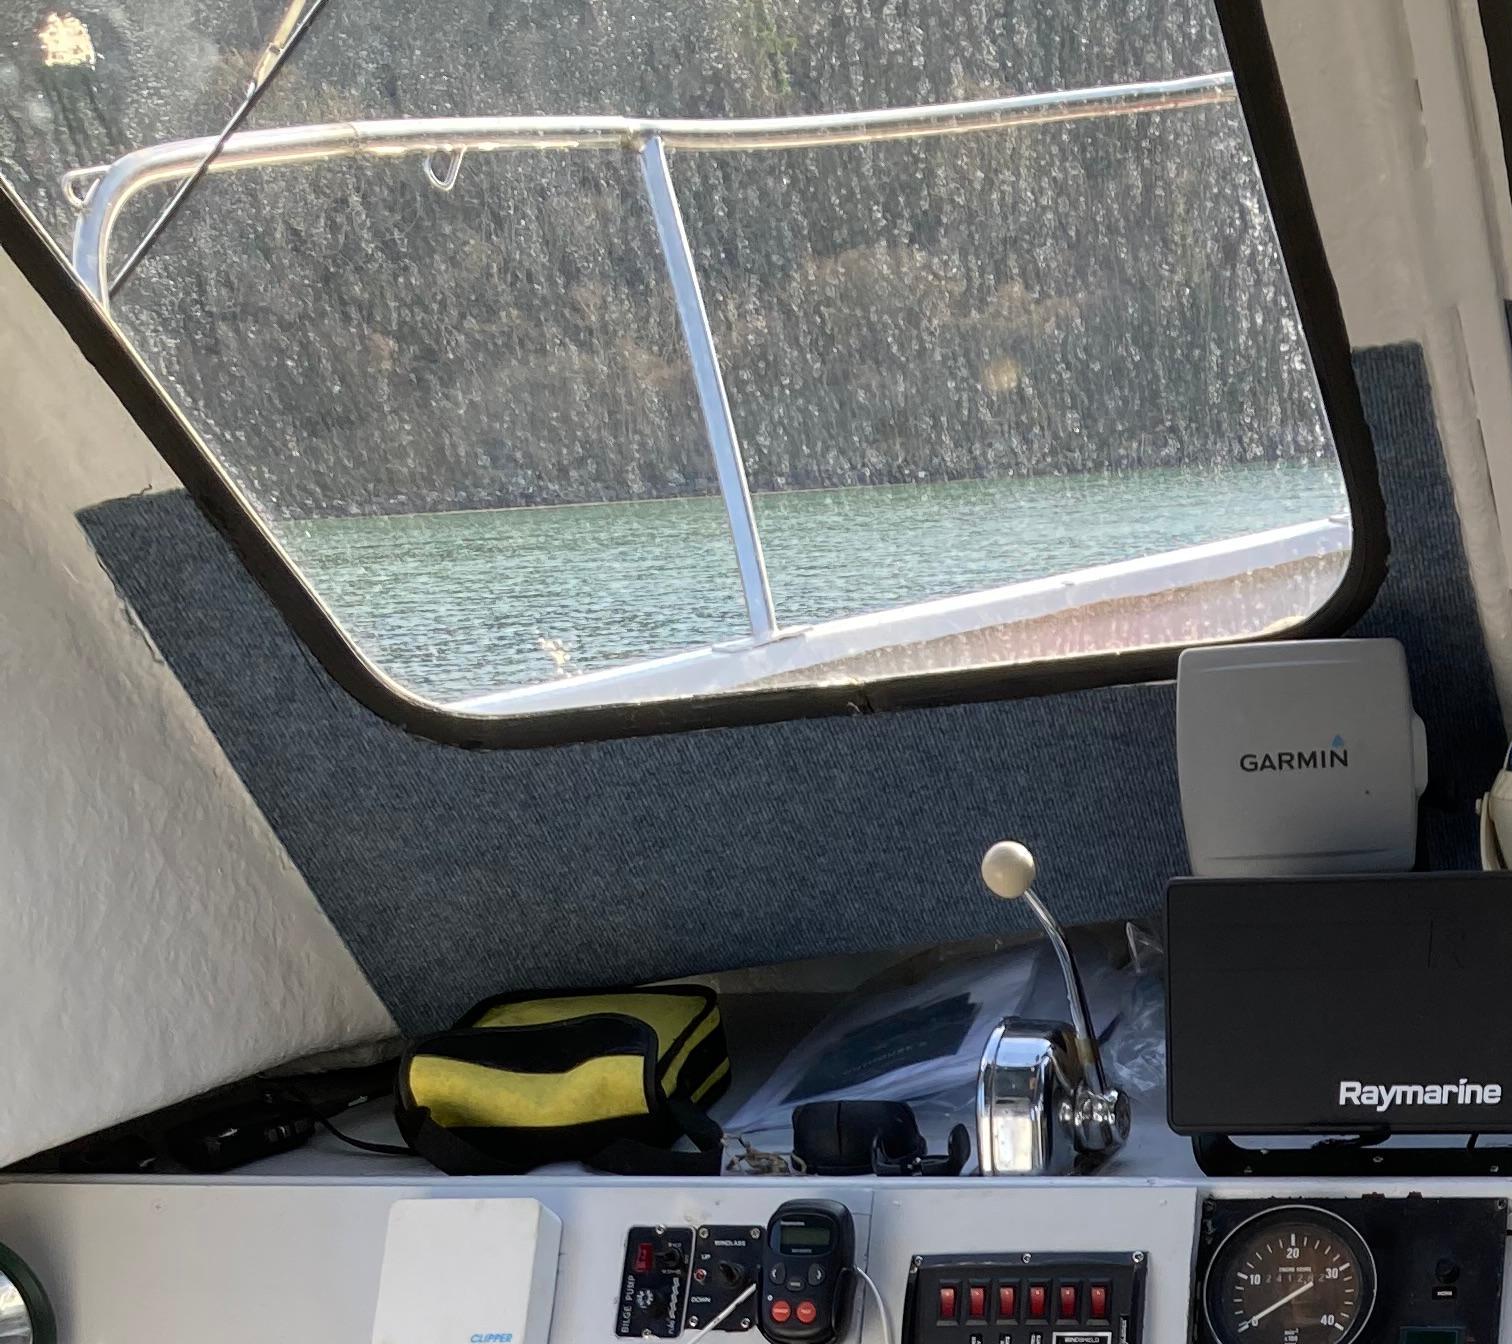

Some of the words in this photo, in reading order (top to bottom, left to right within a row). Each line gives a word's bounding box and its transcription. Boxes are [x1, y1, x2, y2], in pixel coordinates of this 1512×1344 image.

[1240, 748, 1349, 772] GARMIN
[1339, 1078, 1502, 1112] Raymarine
[1286, 1248, 1300, 1259] 20
[1325, 1267, 1339, 1279] 30
[1250, 1274, 1261, 1285] 10
[1320, 1314, 1335, 1326] 40
